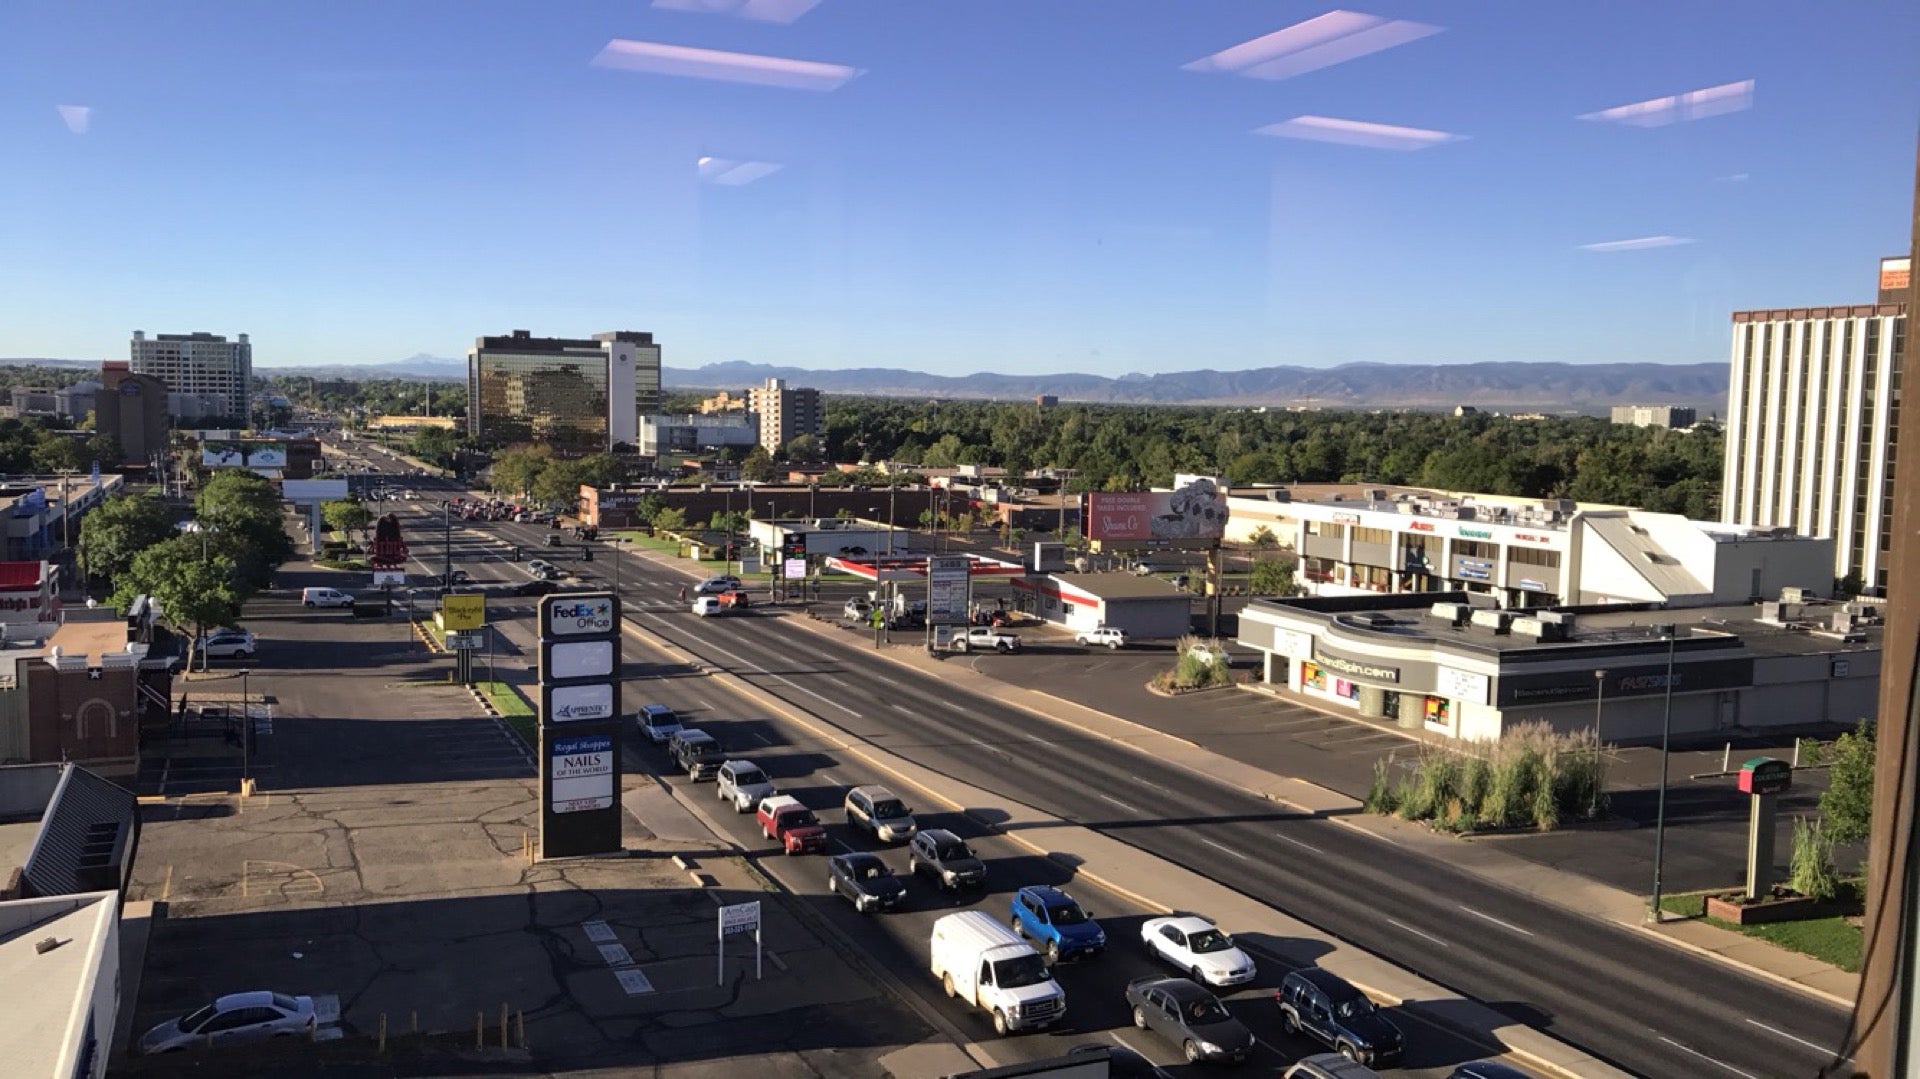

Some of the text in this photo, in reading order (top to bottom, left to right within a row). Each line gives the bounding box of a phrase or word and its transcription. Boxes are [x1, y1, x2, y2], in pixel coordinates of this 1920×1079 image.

[553, 603, 594, 618] FedEx
[576, 617, 610, 629] Office
[554, 740, 612, 754] Regal Shoppes
[563, 754, 601, 769] NAILS
[556, 766, 609, 777] OF THE WORLD
